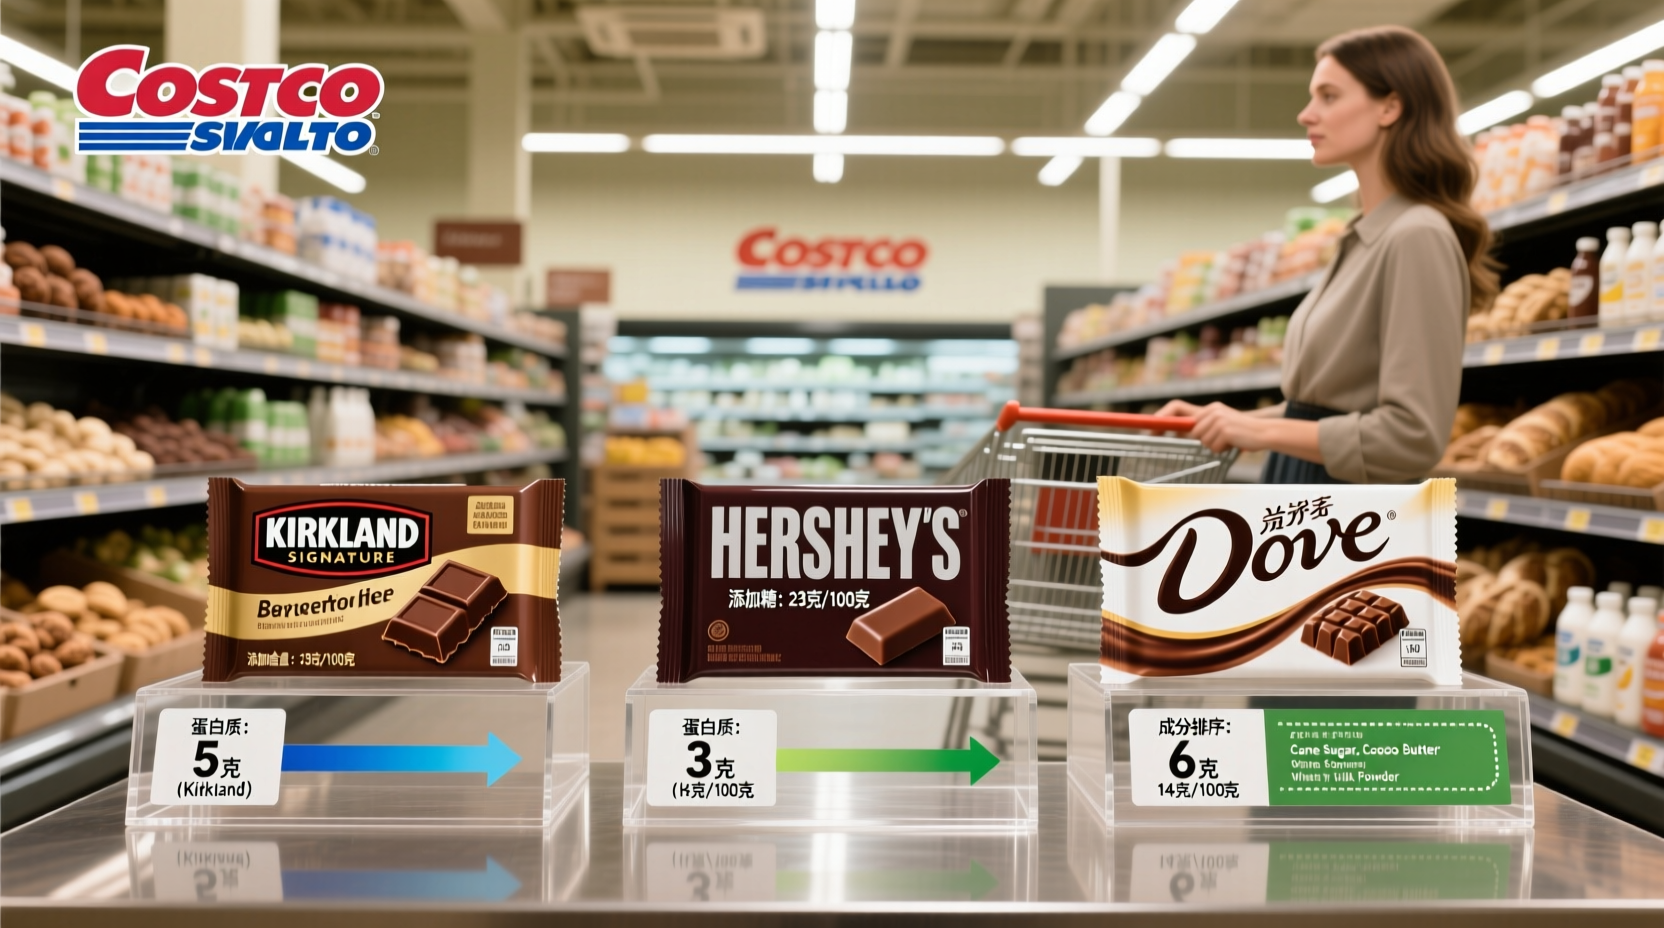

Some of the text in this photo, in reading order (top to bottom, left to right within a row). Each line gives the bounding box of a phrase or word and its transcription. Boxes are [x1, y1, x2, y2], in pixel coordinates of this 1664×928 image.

[737, 228, 928, 268] COSTCO
[266, 516, 420, 549] KIRKLAND
[711, 506, 962, 581] HERSHEY'S
[287, 551, 395, 564] SIGNATURE
[1157, 508, 1390, 615] Dove
